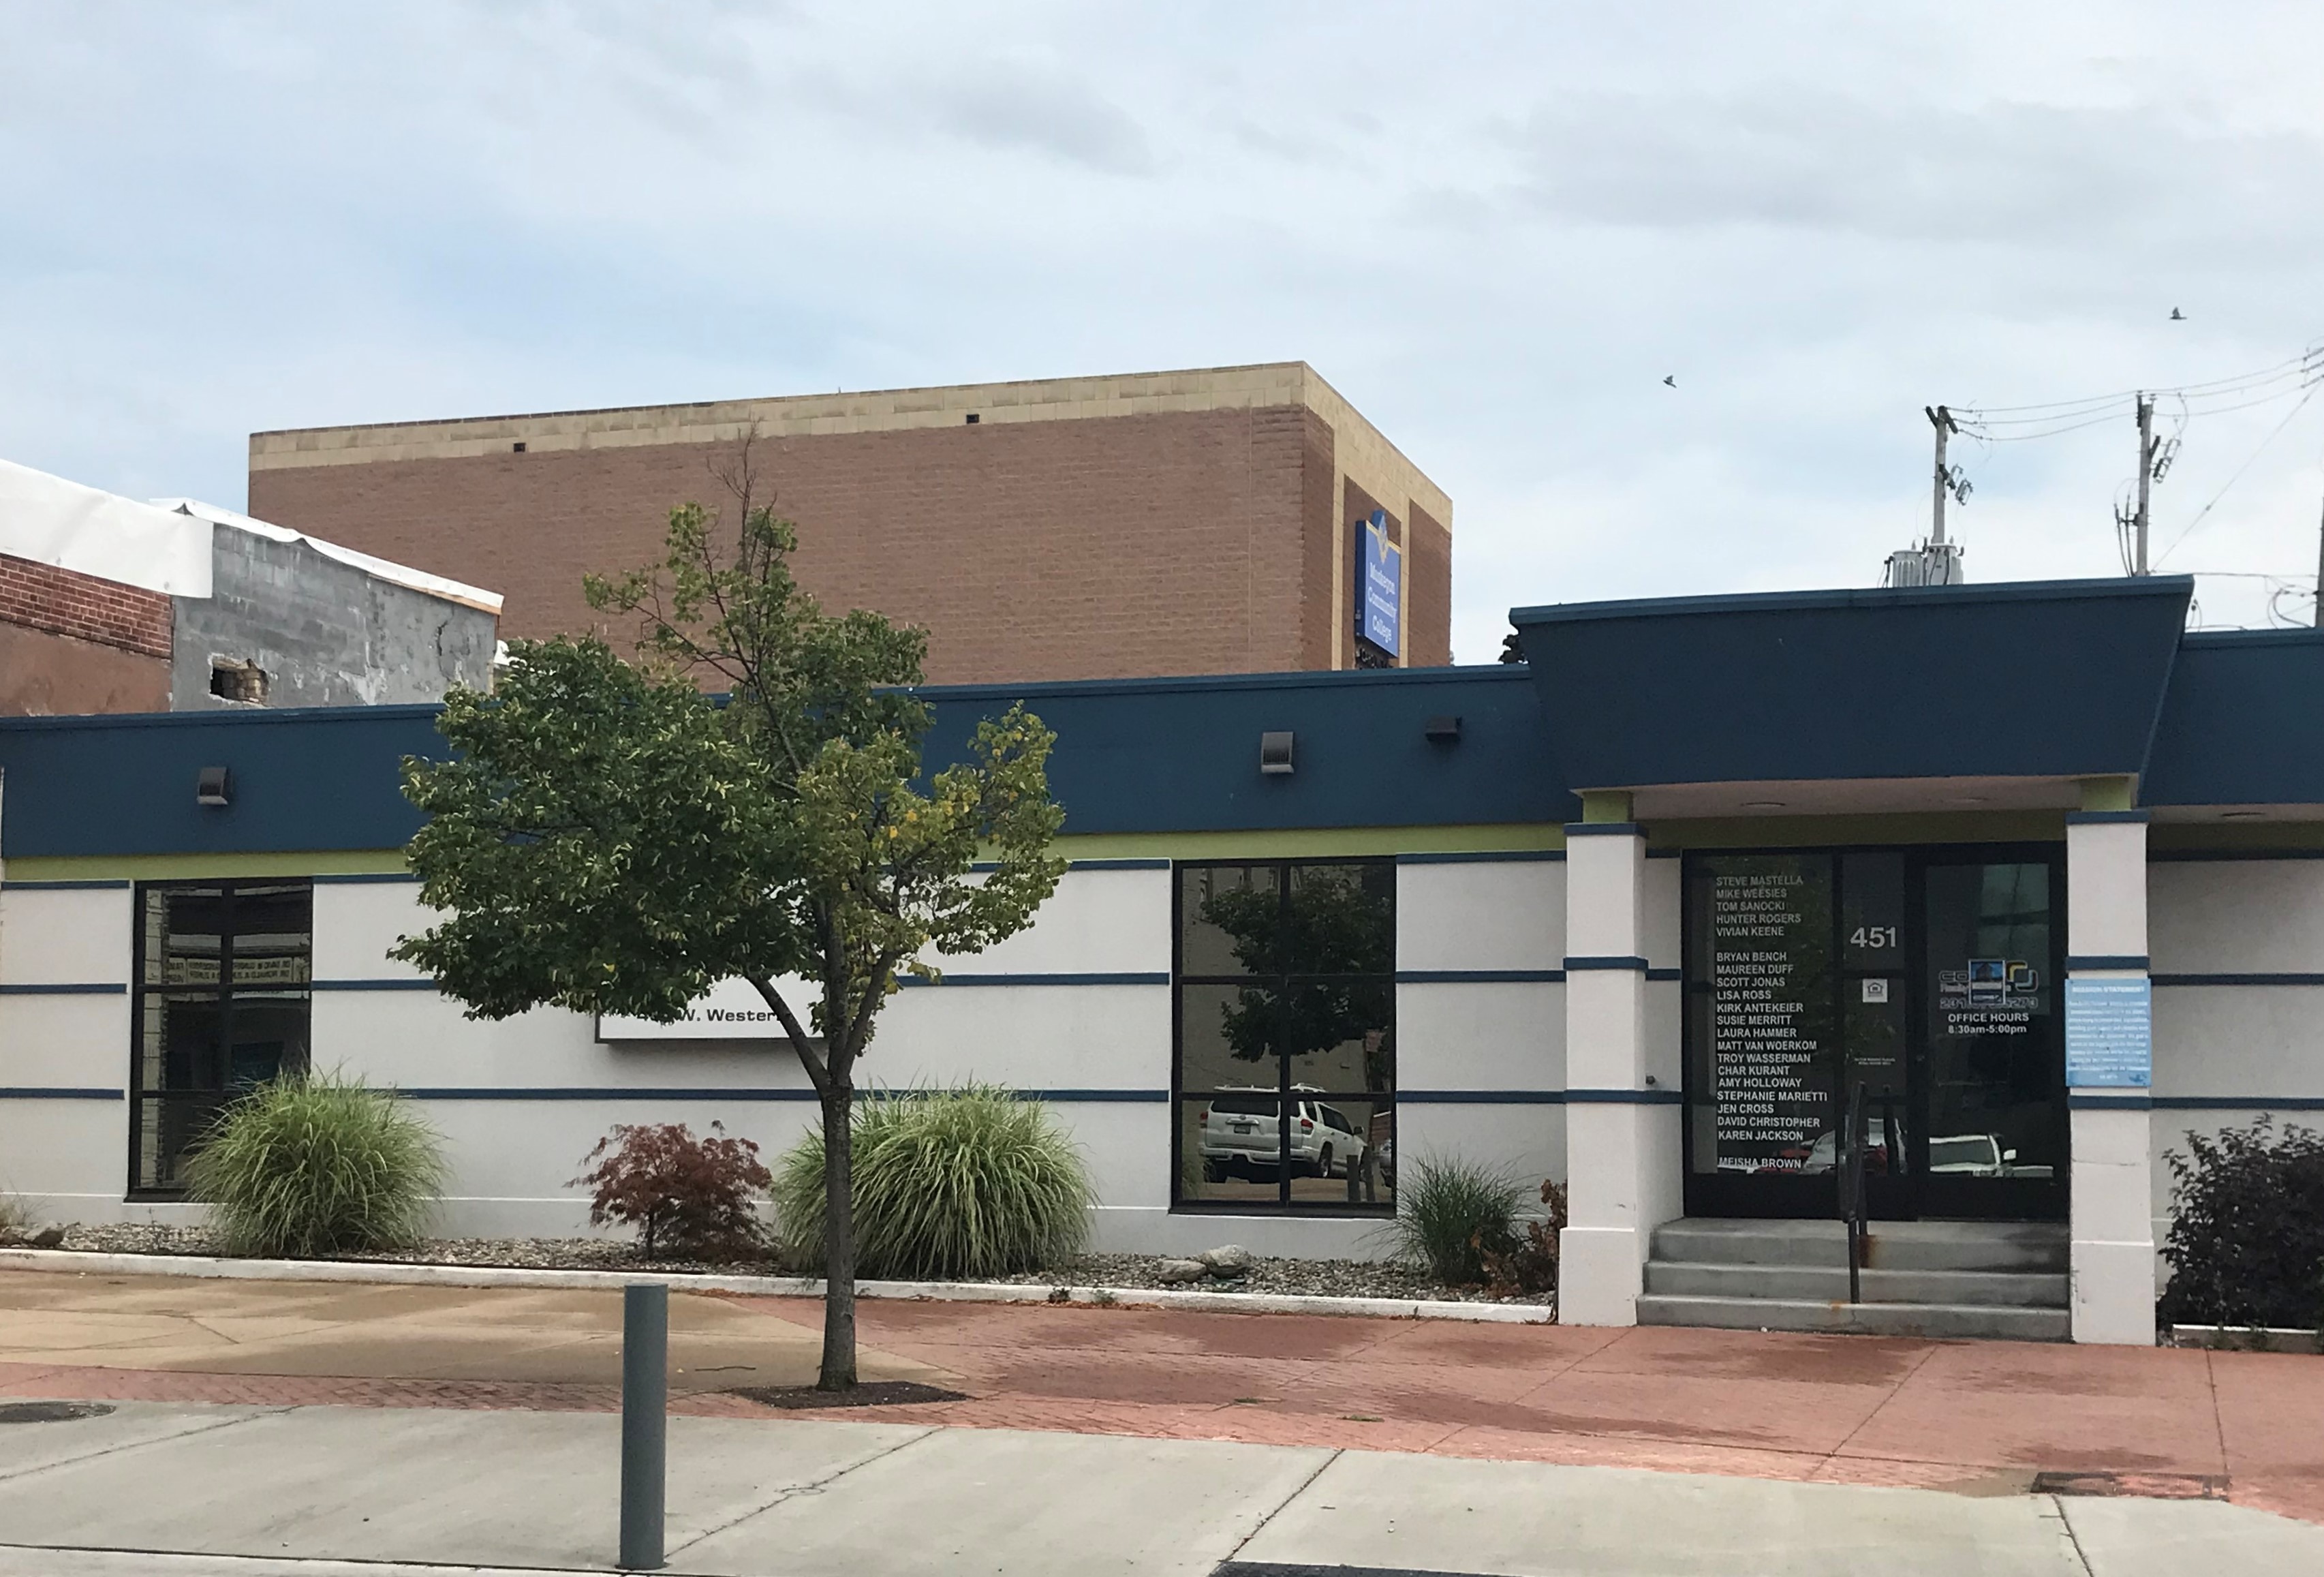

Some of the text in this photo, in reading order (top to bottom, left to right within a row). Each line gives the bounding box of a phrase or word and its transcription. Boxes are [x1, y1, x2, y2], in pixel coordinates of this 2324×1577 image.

[1372, 615, 1392, 643] College
[1716, 876, 1803, 886] STEVE MASTELLA
[1716, 889, 1787, 898] MIKE WEESIES
[1716, 902, 1785, 911] TOM SANOCKI
[1716, 914, 1801, 923] HUNTER ROGERS
[1716, 927, 1784, 936] VIVIAN KEENE
[1850, 927, 1896, 947] 451
[1717, 952, 1787, 961] BRYAN BENCH
[1717, 964, 1794, 974] MAUREEN DUFF
[1717, 977, 1786, 987] SCOTT JONAS
[1717, 990, 1771, 1000] LISA ROSS
[1717, 1003, 1803, 1012] KIRK ANTEKEIER
[1717, 1015, 1792, 1024] SUSIE MERRITT
[1948, 1012, 2030, 1023] OFFICE HOURS
[1717, 1028, 1797, 1037] LAURA HAMMER
[1948, 1024, 2028, 1035] 8:30am-5:00pm
[1718, 1041, 1817, 1050] MATT VAN WOERKOM
[1718, 1054, 1811, 1062] TROY WASSERMAN
[1718, 1066, 1790, 1075] CHAR KURANT
[1718, 1078, 1802, 1087] AMY HOLLOWAY
[1717, 1091, 1827, 1101] STEPHANIE MARIETTI
[1718, 1104, 1774, 1113] JEN CROSS
[1718, 1117, 1821, 1127] DAVID CHRISTOPHER
[1718, 1131, 1803, 1140] KAREN JACKSON
[1718, 1157, 1802, 1169] MEISHA BROWN
